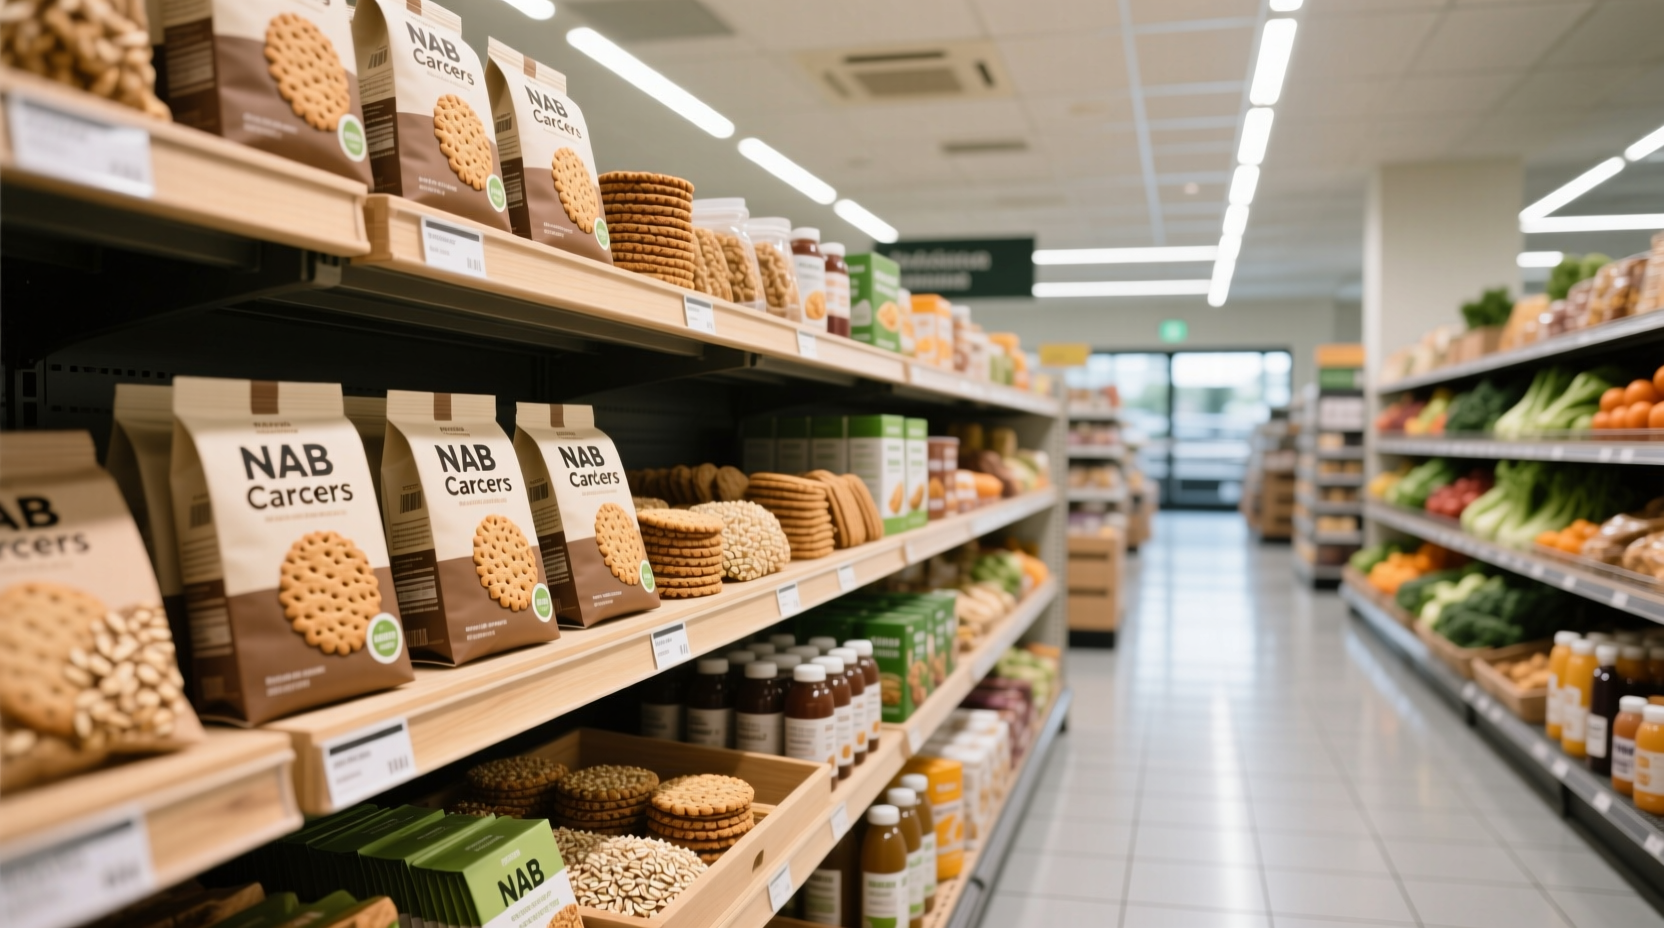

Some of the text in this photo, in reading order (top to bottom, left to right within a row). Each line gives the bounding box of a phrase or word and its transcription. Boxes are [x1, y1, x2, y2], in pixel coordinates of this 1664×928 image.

[406, 21, 461, 63] NAB
[413, 48, 475, 86] Carcers
[525, 85, 568, 118] NAB
[239, 444, 334, 480] NAB
[434, 444, 496, 473] NAB
[558, 446, 605, 469] NAB
[247, 483, 354, 510] Carcers
[445, 475, 512, 496] Carcers
[497, 858, 545, 907] NAB
